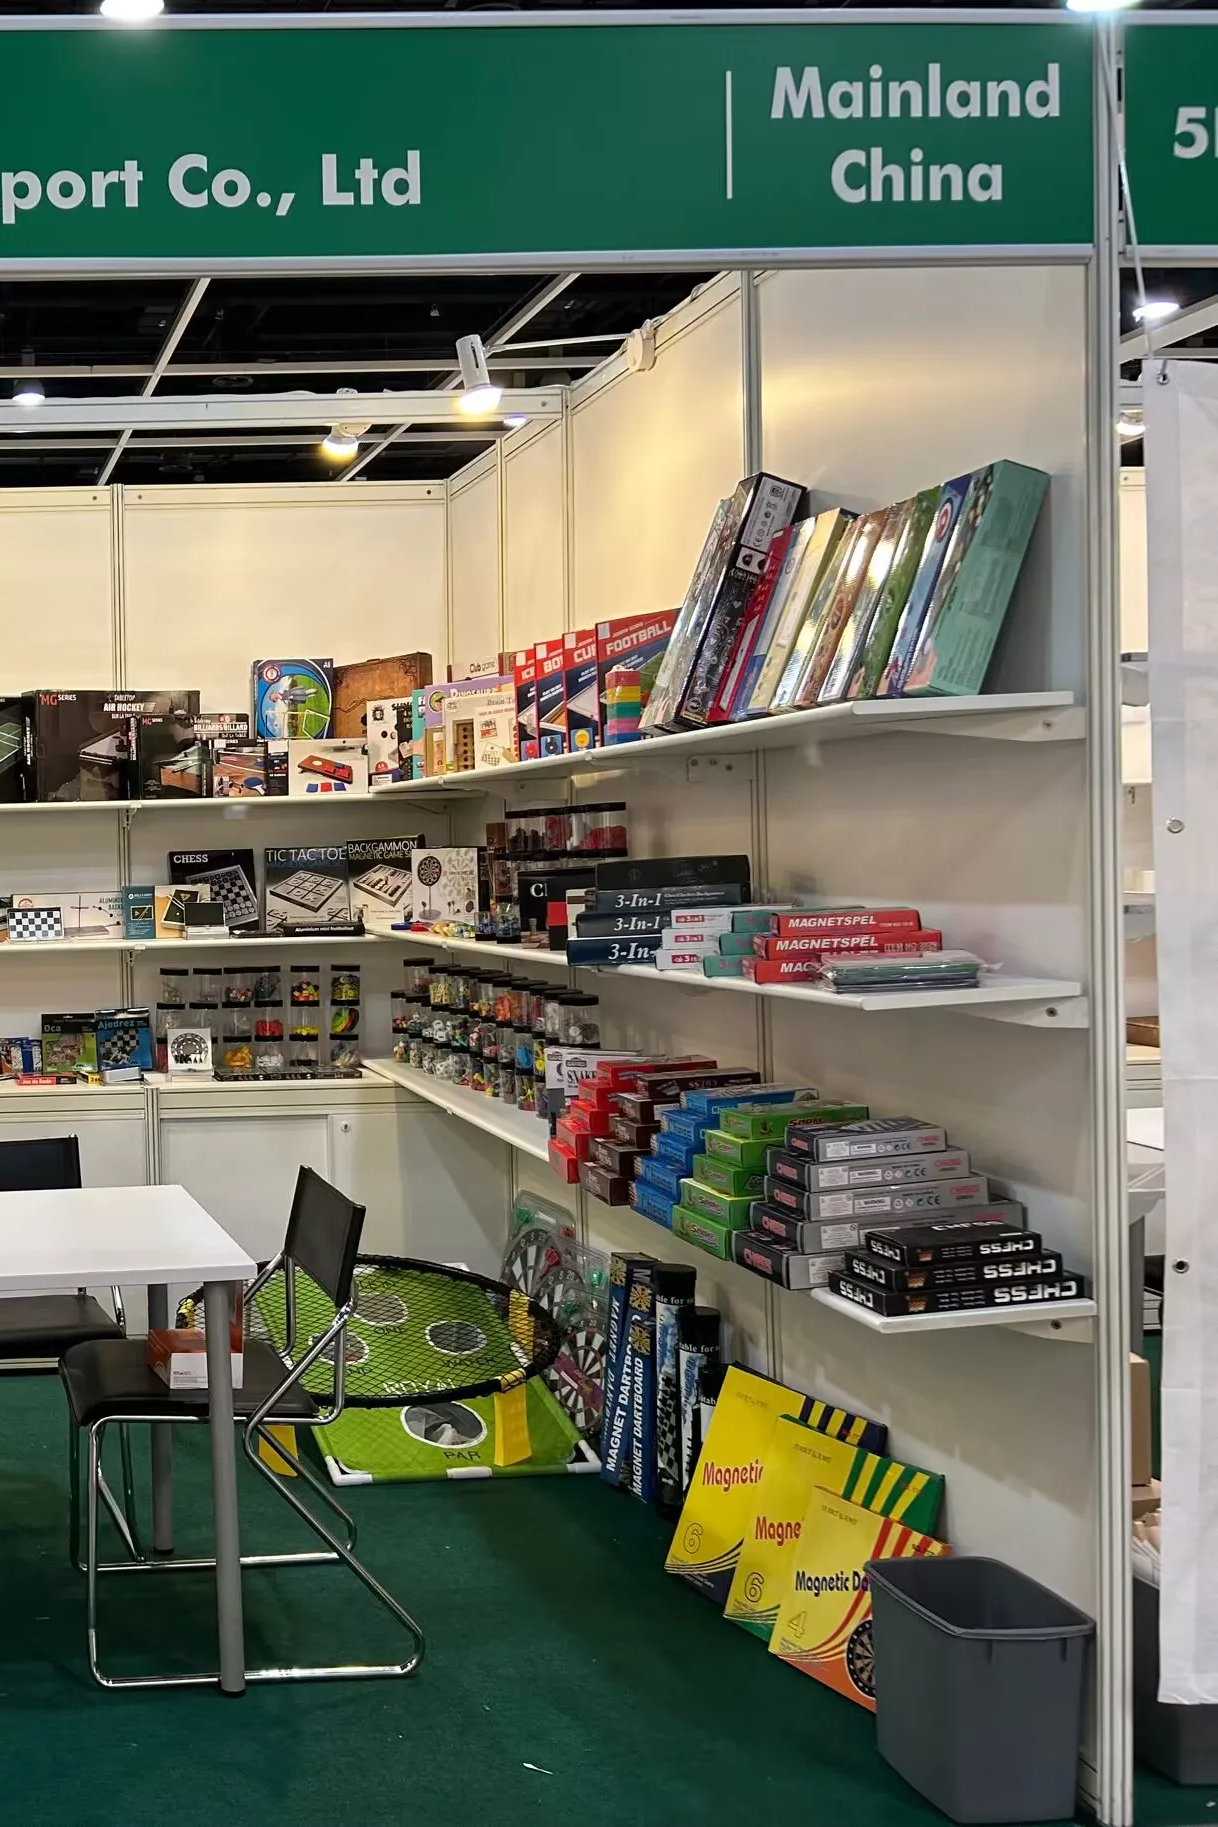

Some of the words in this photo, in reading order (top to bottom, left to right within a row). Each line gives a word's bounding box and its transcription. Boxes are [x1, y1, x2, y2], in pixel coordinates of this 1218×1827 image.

[771, 62, 1061, 119] Mainland
[1172, 106, 1218, 160] 5
[830, 146, 1004, 204] China
[167, 153, 296, 219] Co.,
[322, 150, 422, 207] Ltd
[605, 620, 672, 656] FOOTBALL
[42, 695, 57, 705] MG
[103, 702, 116, 712] AIR
[117, 702, 145, 712] HOCKEY
[348, 840, 418, 854] BACKGAMMON
[173, 854, 209, 864] CHESS
[266, 849, 287, 863] TIC
[289, 848, 317, 862] TAC
[319, 848, 347, 861] TOE
[615, 892, 661, 908] 3-In-1
[614, 916, 660, 932] 3-In-1
[788, 915, 877, 928] MAGNETSPEL
[776, 936, 879, 951] MAGNETSPEL
[43, 1024, 62, 1032] Oca
[97, 1019, 135, 1030] Ajedrez
[700, 1344, 714, 1353] for
[632, 1357, 643, 1440] DARTBOARD
[606, 1405, 627, 1472] MAGNET
[443, 1451, 482, 1461] PAR
[631, 1441, 643, 1497] MAGNET
[684, 1522, 704, 1554] 6
[744, 1571, 765, 1603] 6
[795, 1570, 849, 1598] Magnetic
[787, 1610, 808, 1639] 4
